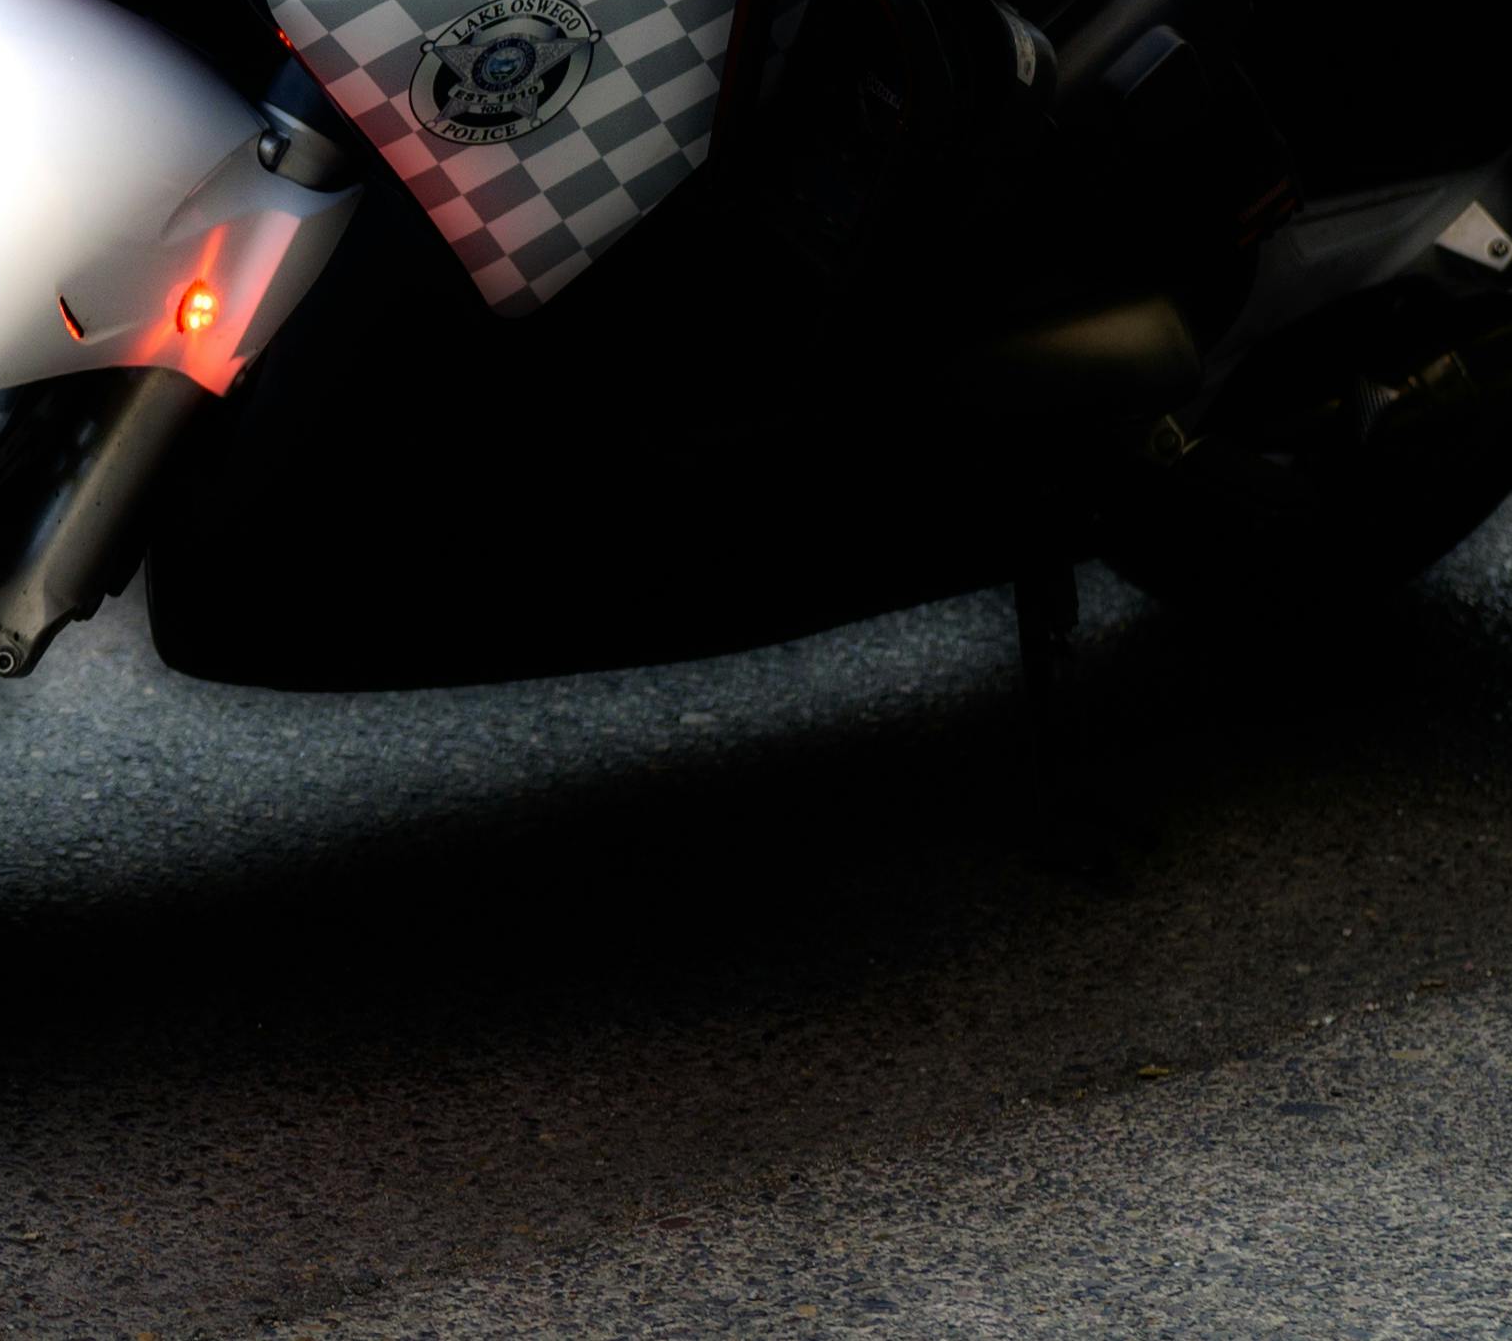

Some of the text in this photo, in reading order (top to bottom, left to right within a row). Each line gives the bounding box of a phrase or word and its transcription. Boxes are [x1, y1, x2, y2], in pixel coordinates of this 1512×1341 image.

[451, 3, 506, 40] LAKE
[453, 85, 538, 104] EST. 1910
[440, 122, 519, 143] POLICE
